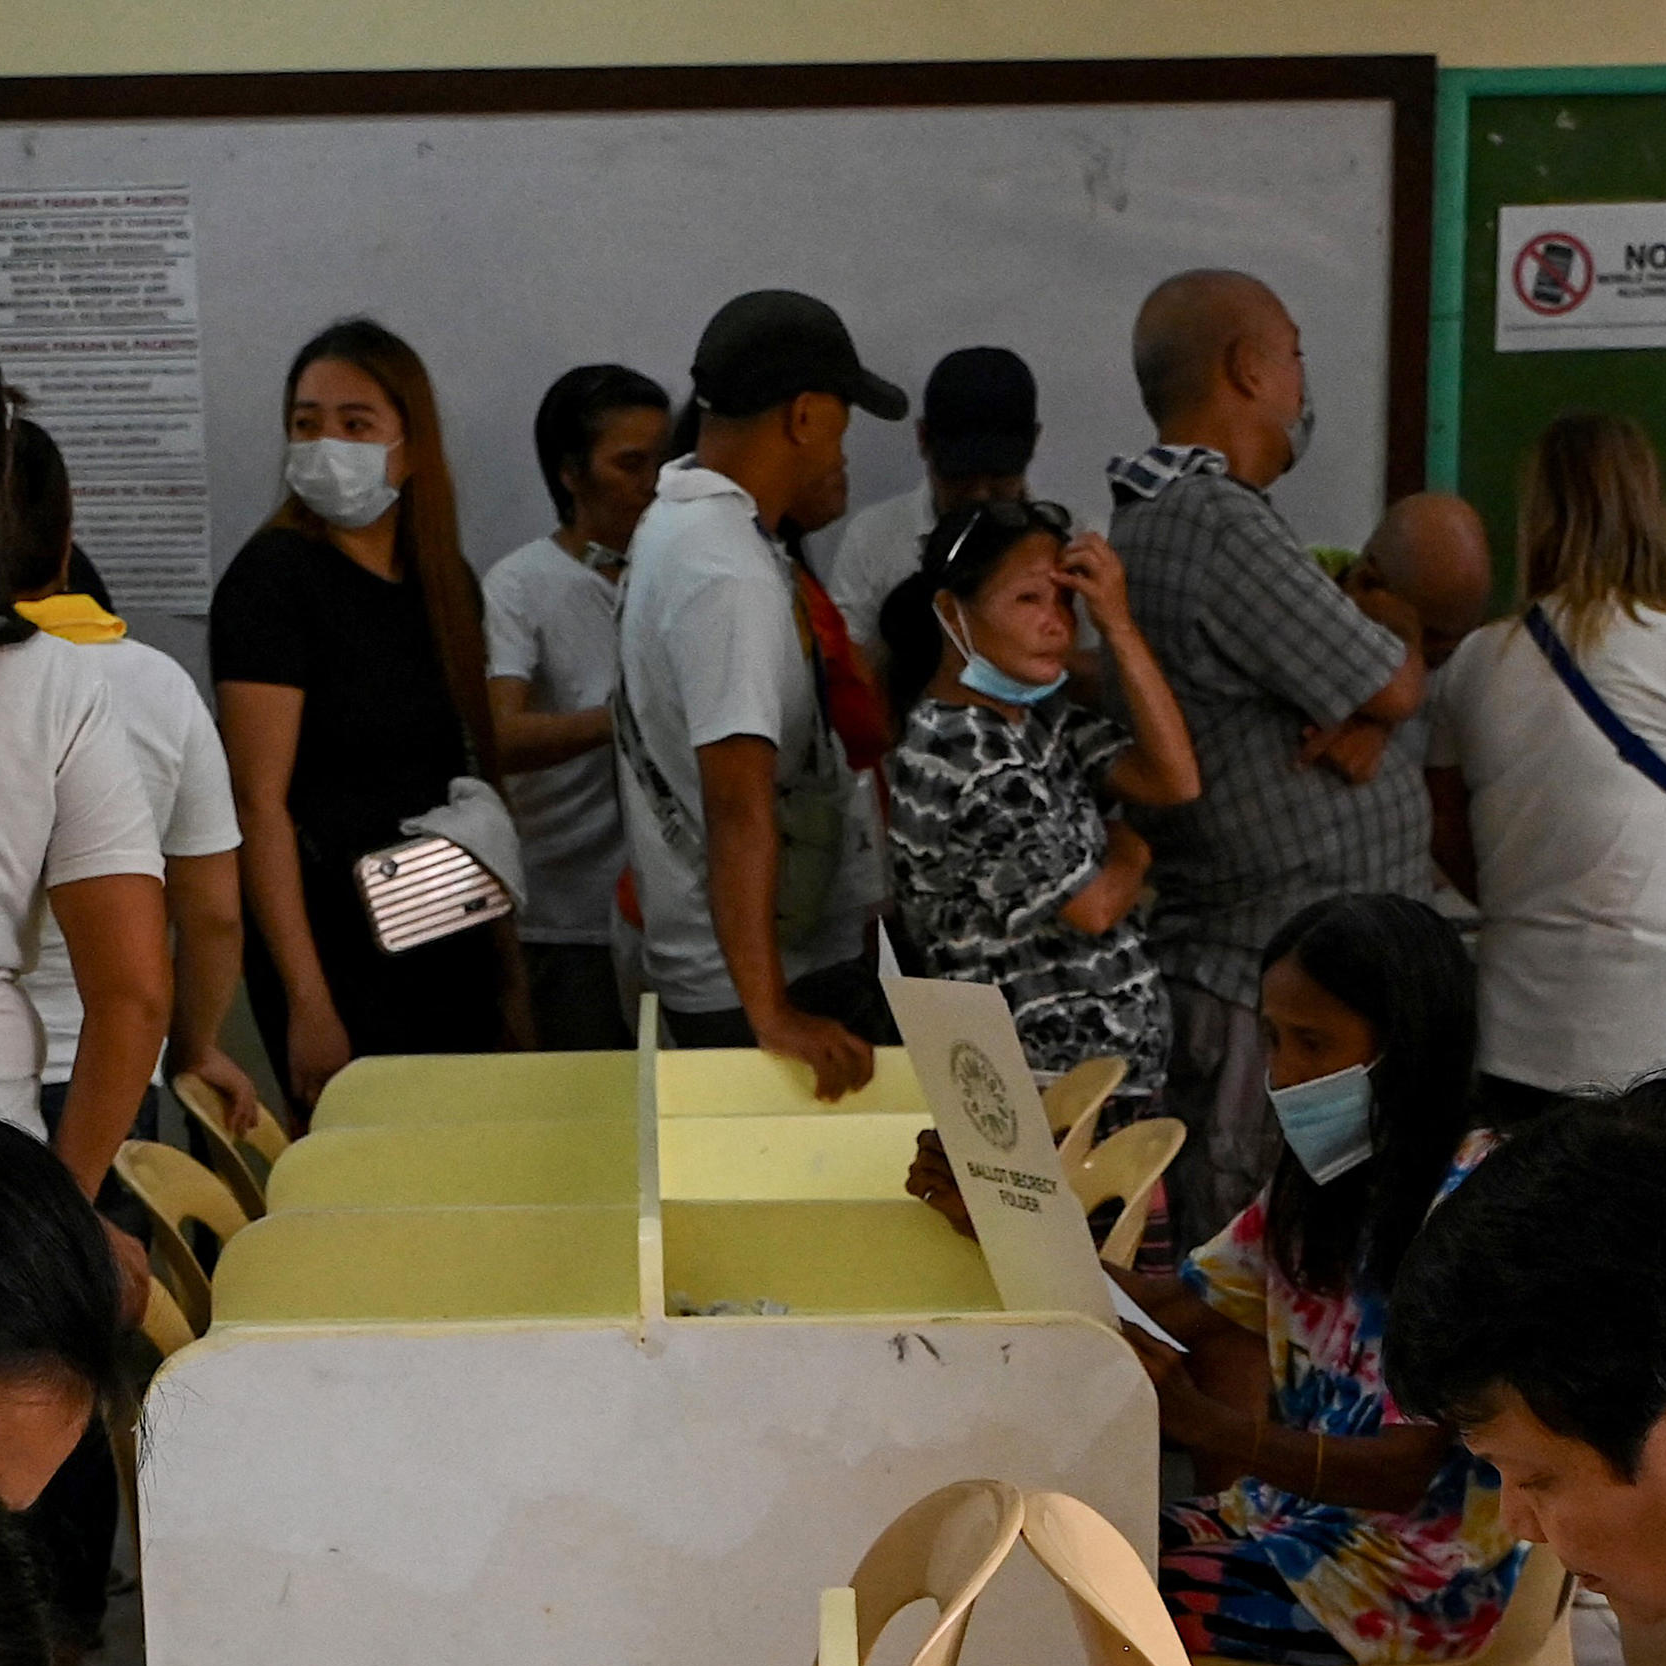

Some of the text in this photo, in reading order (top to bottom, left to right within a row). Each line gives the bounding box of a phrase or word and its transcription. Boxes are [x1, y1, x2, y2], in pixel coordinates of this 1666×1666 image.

[967, 1162, 1058, 1195] BALLOT SECRECY
[999, 1189, 1043, 1214] FOLDER
